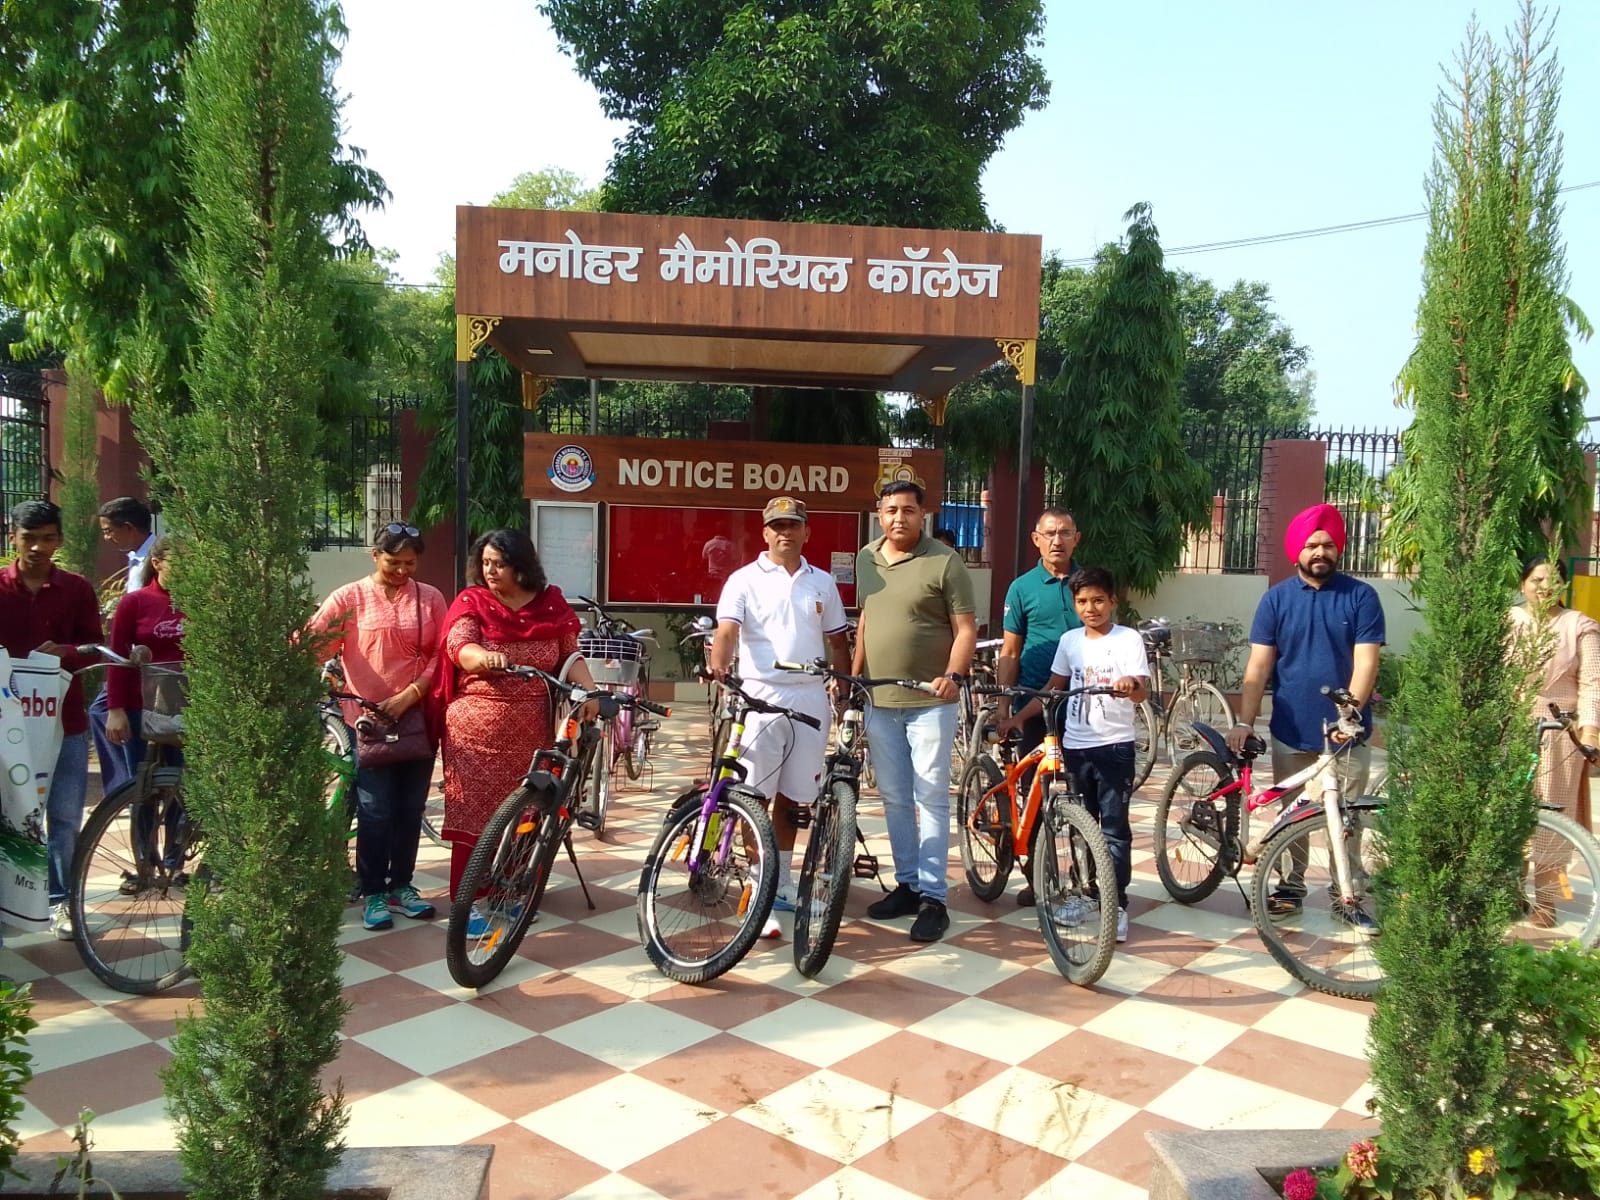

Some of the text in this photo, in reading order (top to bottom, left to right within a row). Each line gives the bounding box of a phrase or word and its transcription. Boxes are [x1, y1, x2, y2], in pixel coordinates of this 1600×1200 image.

[498, 229, 1002, 298] मनोहर मैमोरियल कॉलेज
[618, 458, 734, 489] NOTICE
[744, 463, 849, 492] BOARD
[15, 874, 37, 891] Mrs.
